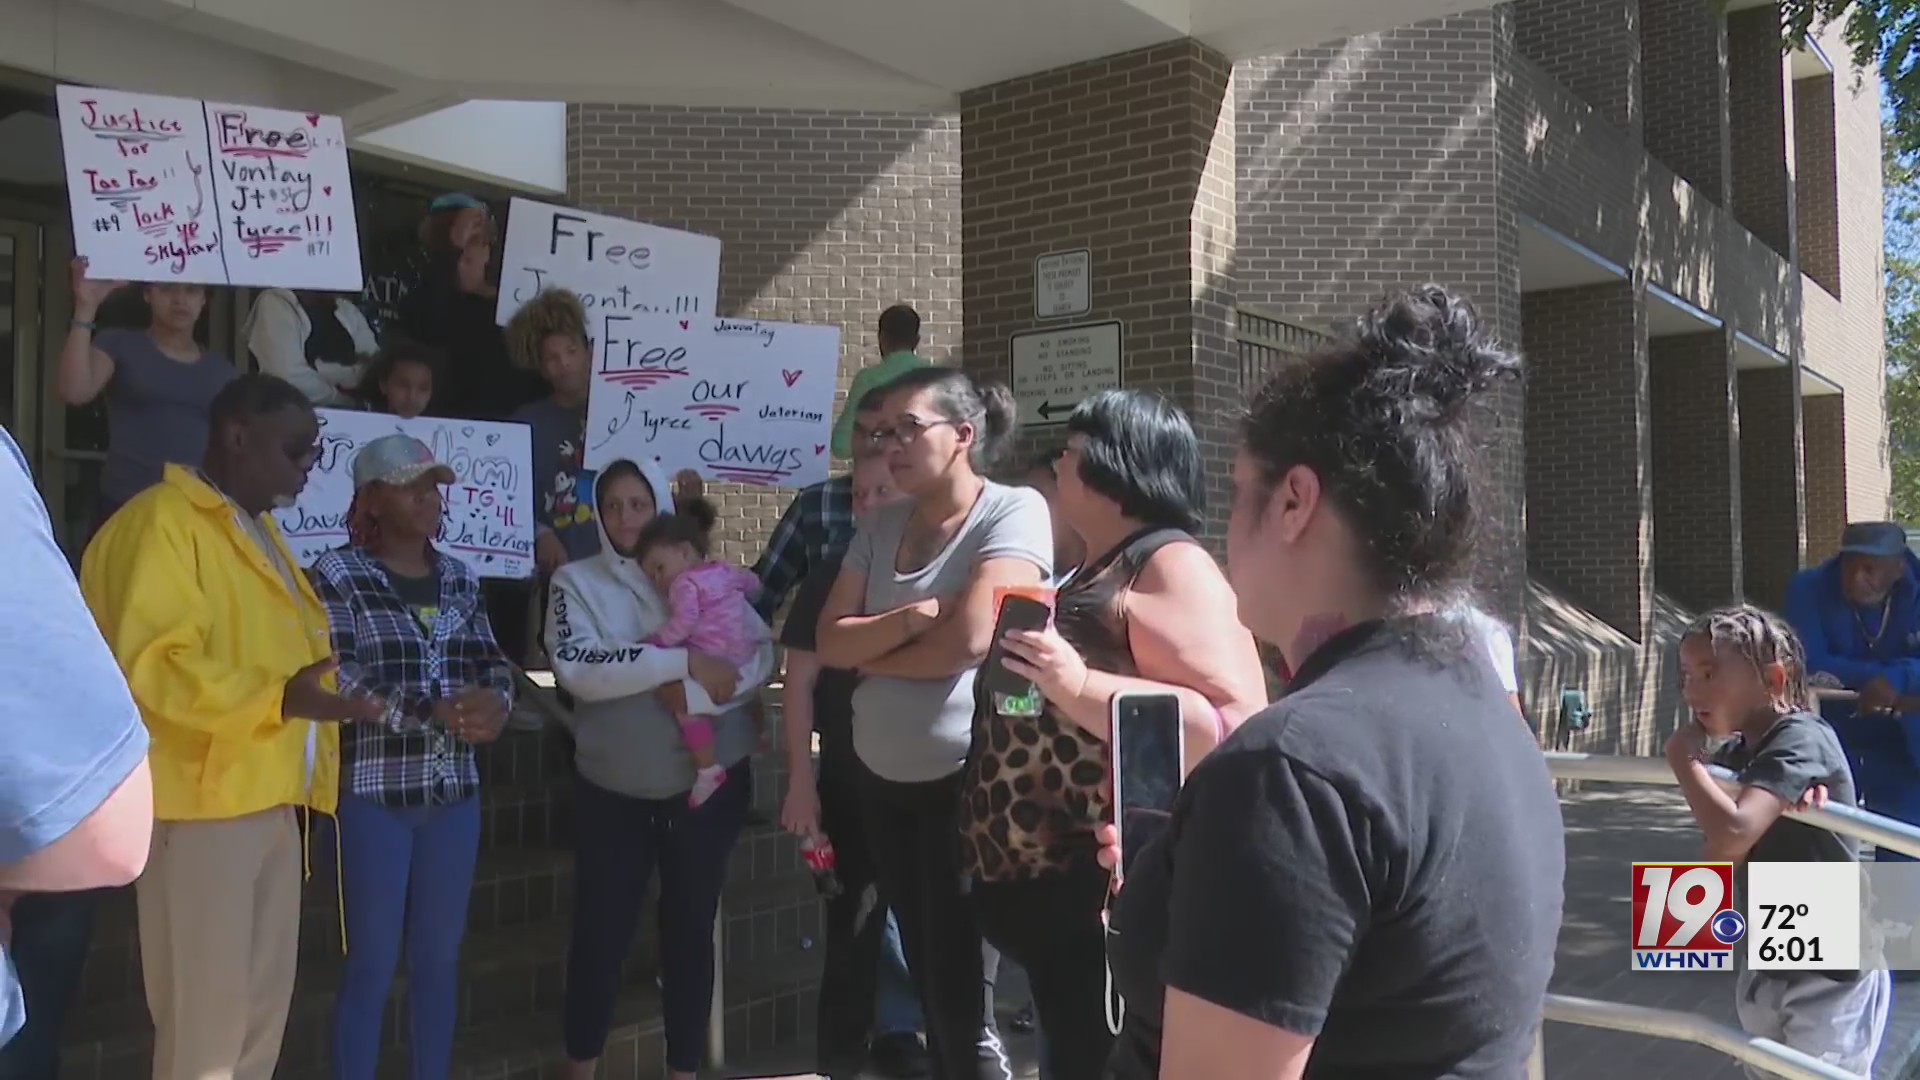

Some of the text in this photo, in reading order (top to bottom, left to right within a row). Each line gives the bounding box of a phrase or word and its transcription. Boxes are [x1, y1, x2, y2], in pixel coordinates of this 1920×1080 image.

[80, 101, 182, 131] Justice
[94, 214, 120, 231] #9
[550, 213, 651, 270] Free
[602, 316, 688, 373] Free
[1056, 346, 1092, 358] STANDING
[1082, 367, 1114, 378] LANDING
[692, 379, 750, 402] our
[1054, 386, 1073, 395] AREA
[643, 409, 693, 444] Tyree
[698, 422, 803, 482] dawgs
